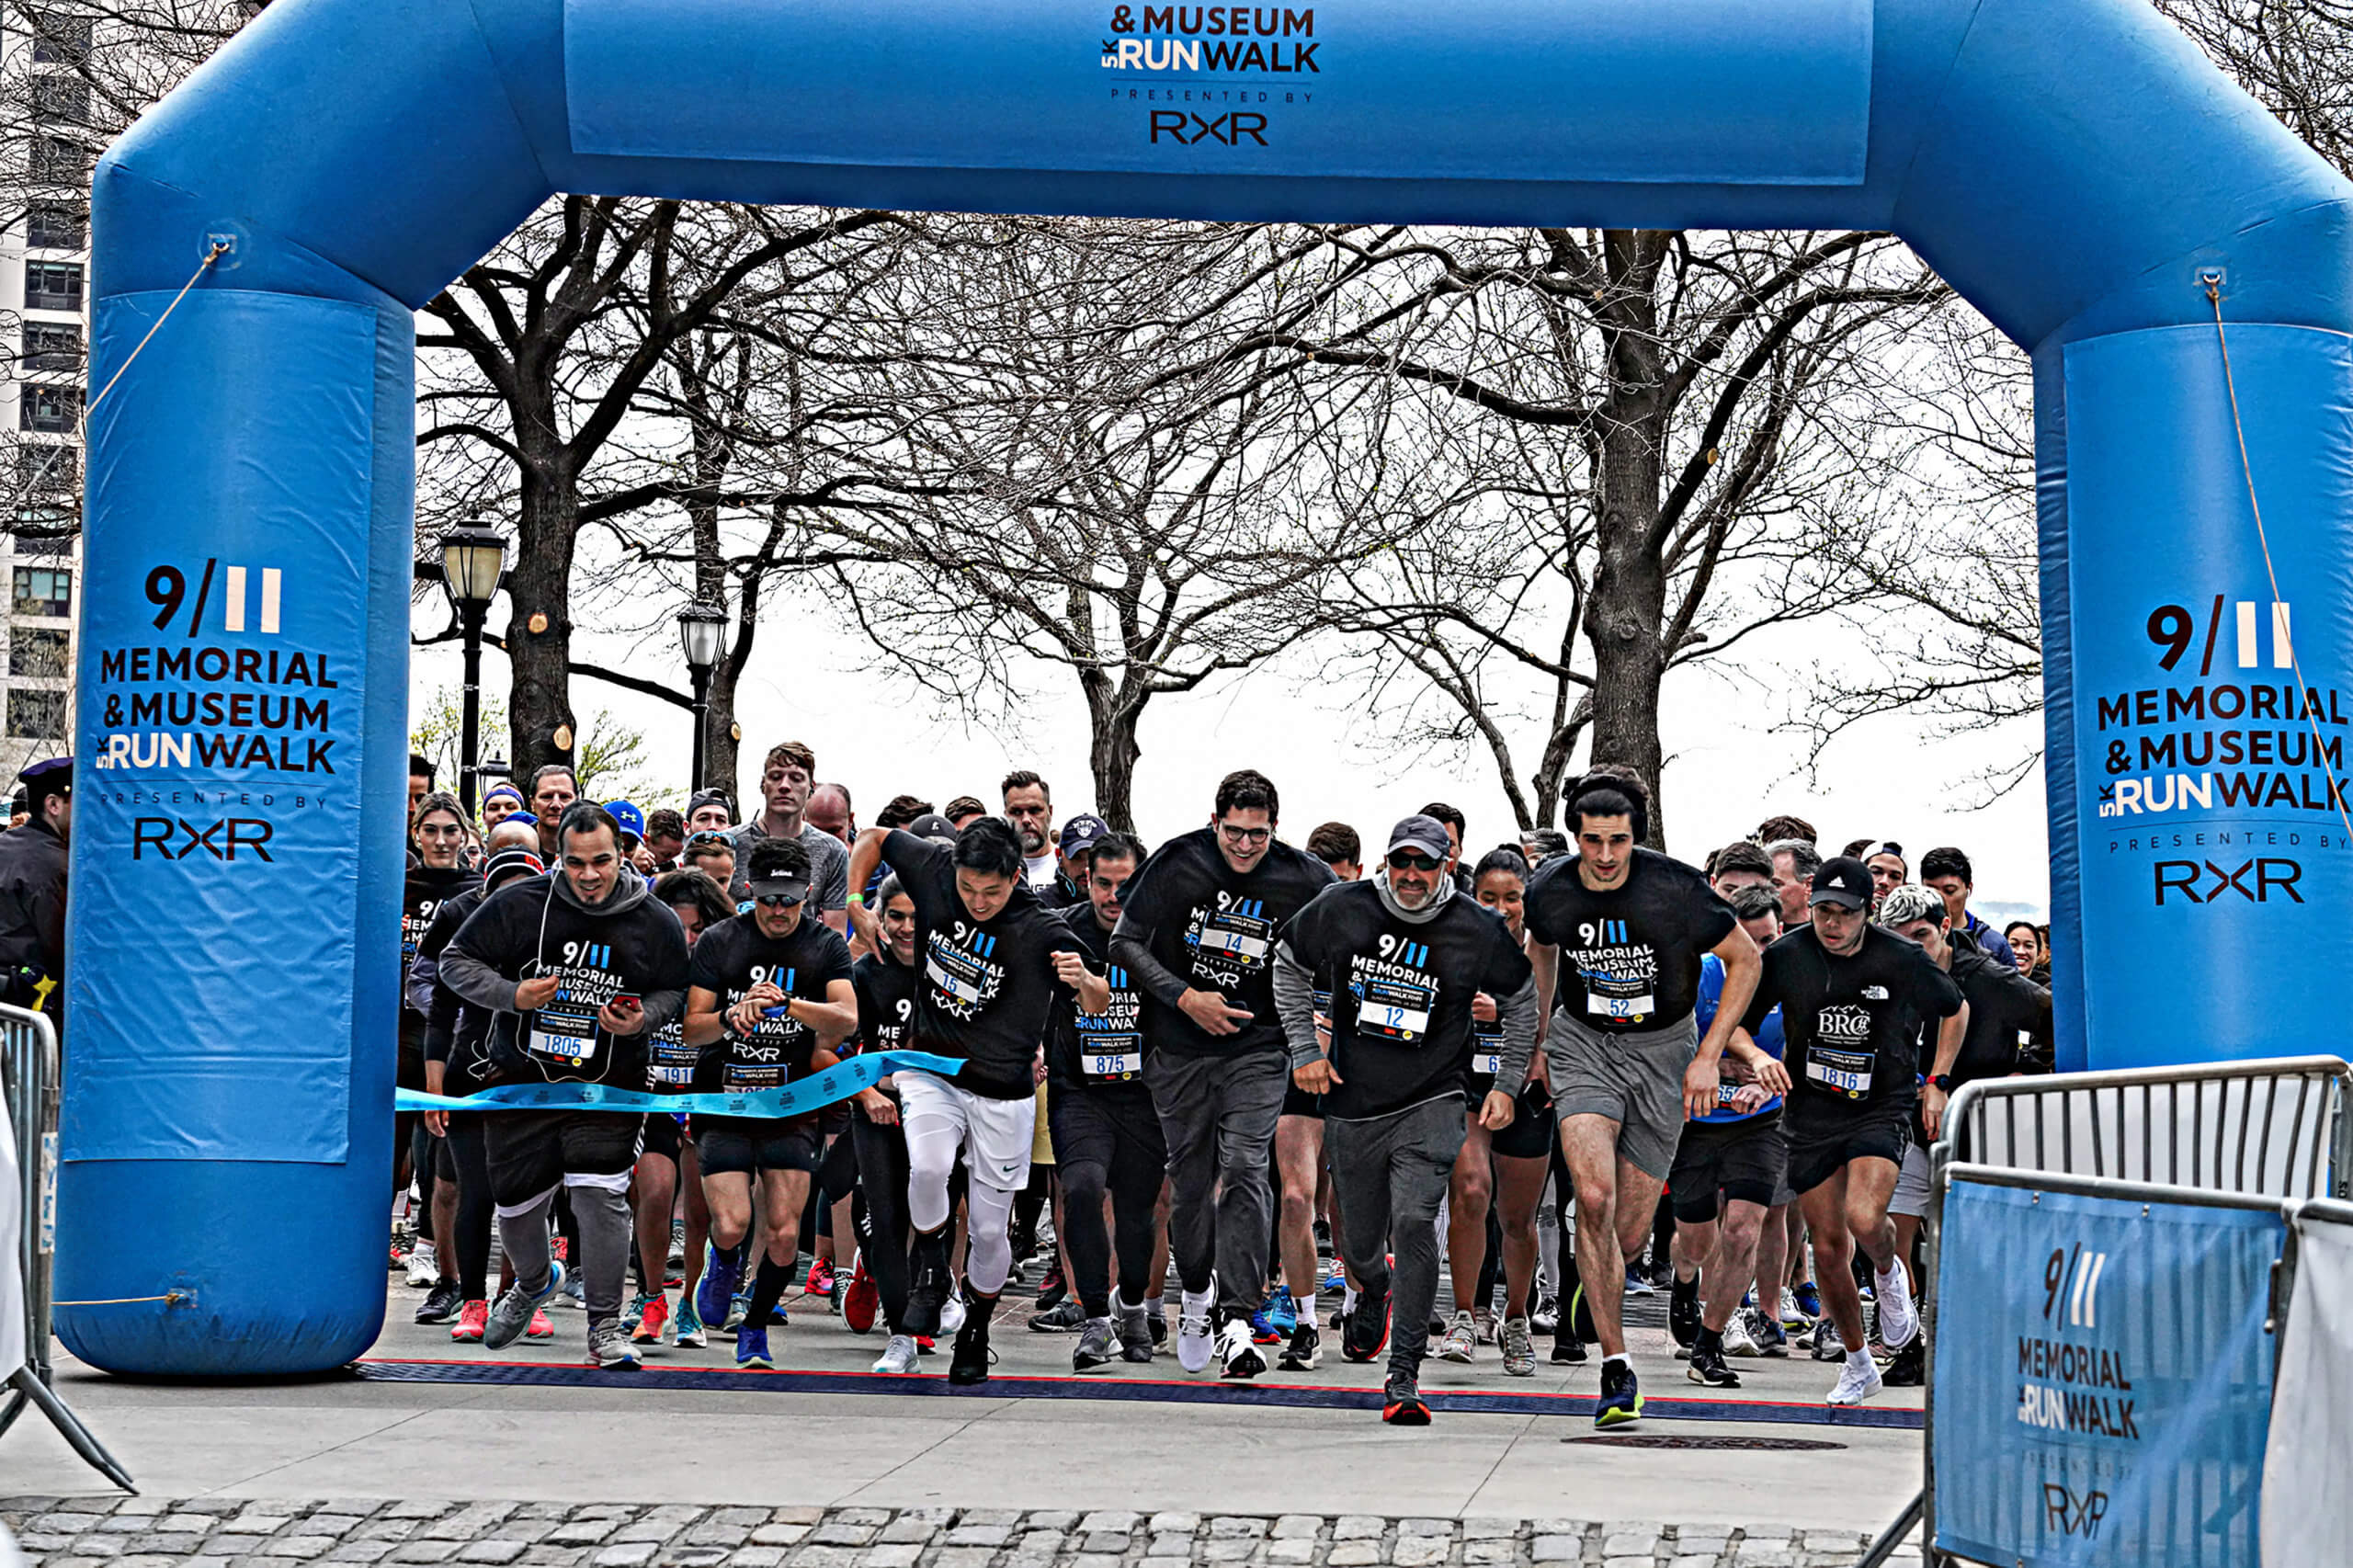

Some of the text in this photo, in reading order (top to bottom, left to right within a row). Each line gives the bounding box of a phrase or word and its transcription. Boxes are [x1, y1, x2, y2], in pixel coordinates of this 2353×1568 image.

[1110, 6, 1314, 38] & MUSEUM
[1110, 89, 1313, 104] PRESENTED BY
[1150, 110, 1269, 147] RXR
[144, 557, 282, 639] 9/11
[2146, 594, 2293, 677] 9/11
[101, 646, 339, 689] MEMORIAL
[103, 691, 330, 733] & MUSEUM
[2097, 685, 2349, 732] MEMORIAL
[2105, 731, 2344, 776] & MUSEUM
[100, 791, 327, 810] PRESENTED BY
[133, 816, 275, 862] RXR
[2109, 832, 2347, 854] PRESENTED BY
[2154, 858, 2305, 906] RXR
[1217, 890, 1264, 920] 9/11
[954, 920, 997, 959] 9/11
[1225, 933, 1244, 953] 14
[1578, 917, 1628, 948] 9/11
[563, 940, 611, 970] 9/11
[927, 928, 1006, 979] MEMORIAL
[1379, 934, 1429, 969] 9/11
[1565, 943, 1654, 967] MEMORIAL
[535, 964, 625, 989] MEMORIAL
[942, 972, 958, 994] 15
[1192, 960, 1240, 990] RXR
[1351, 953, 1441, 994] MEMORIAL
[1385, 1006, 1404, 1028] 12
[1609, 999, 1631, 1017] 52
[544, 1034, 582, 1057] 1805
[732, 1040, 780, 1062] RXR
[1096, 1055, 1125, 1074] 875
[1822, 1065, 1859, 1090] 1816
[2043, 1241, 2107, 1332] 9/11
[2017, 1335, 2132, 1391] MEMORIAL
